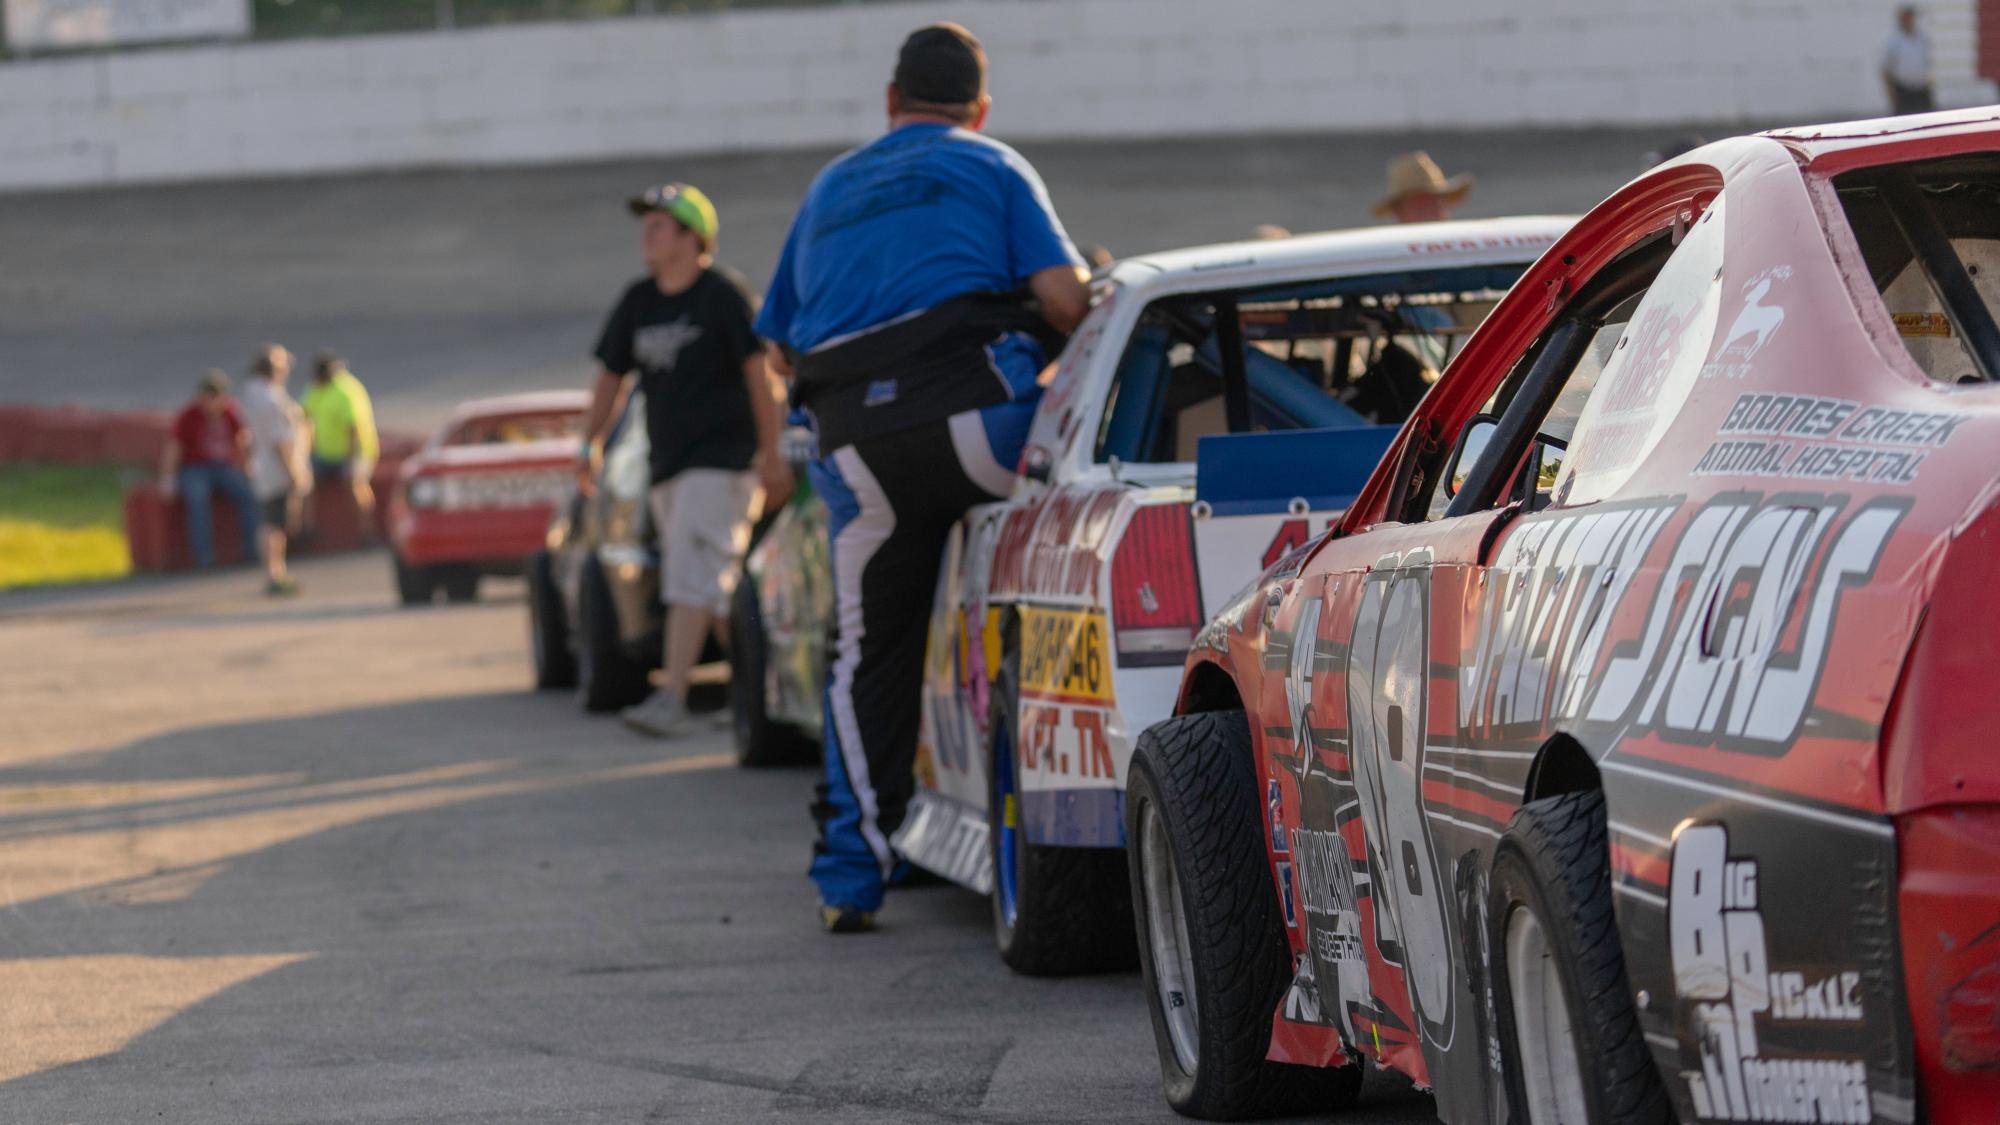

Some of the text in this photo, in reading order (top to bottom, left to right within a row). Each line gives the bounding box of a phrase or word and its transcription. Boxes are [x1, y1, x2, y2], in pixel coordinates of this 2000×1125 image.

[1692, 440, 1789, 474] ANIMAL
[1784, 447, 1926, 484] HOSPITAL
[1719, 393, 1970, 446] BOONES CREEK
[1586, 503, 1904, 744] SIGNS
[1671, 825, 1759, 1001] BIG
[1726, 911, 1864, 1058] PICKLE
